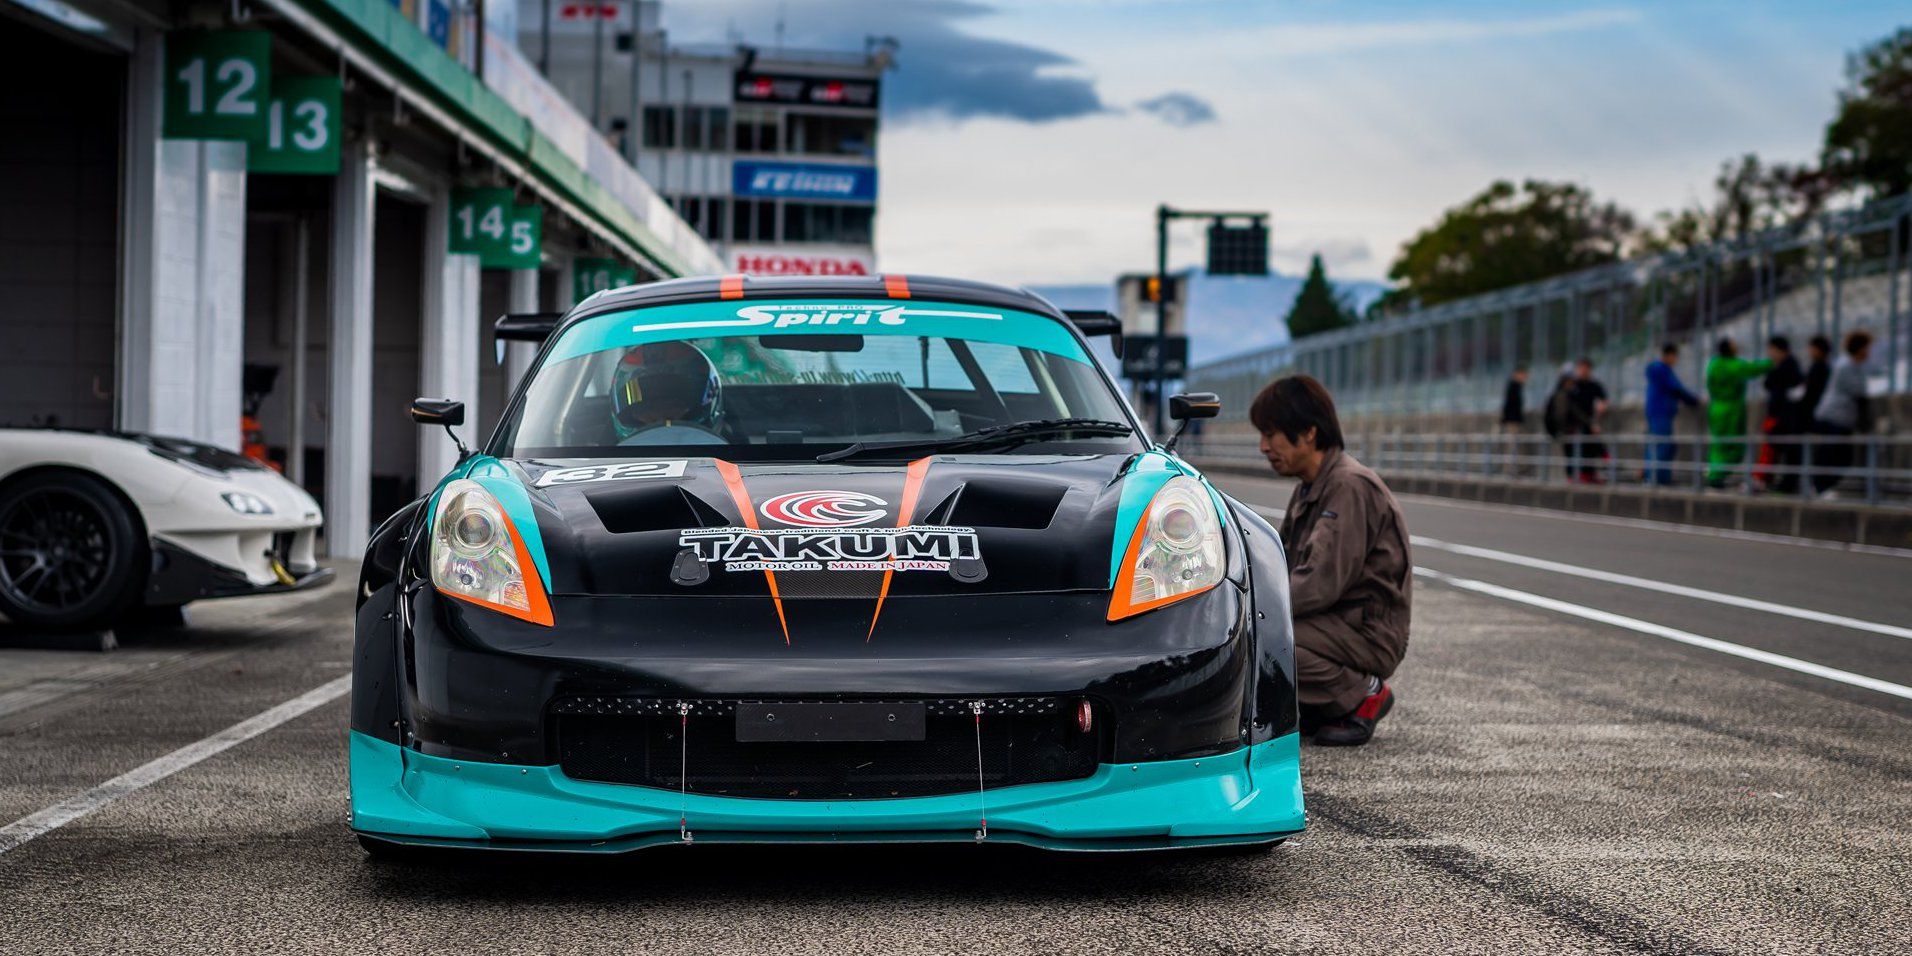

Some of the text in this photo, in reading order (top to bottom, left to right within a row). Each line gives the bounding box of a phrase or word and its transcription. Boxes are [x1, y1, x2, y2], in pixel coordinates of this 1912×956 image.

[177, 58, 257, 115] 12
[268, 99, 329, 150] 13
[457, 205, 505, 240] 14
[510, 221, 534, 255] 5
[736, 253, 869, 276] HONDA
[736, 304, 907, 329] Spirit
[551, 463, 671, 482] 32
[680, 533, 980, 562] TAKUMI
[728, 561, 947, 571] MOTOR OIL MADE IN JAPAN
